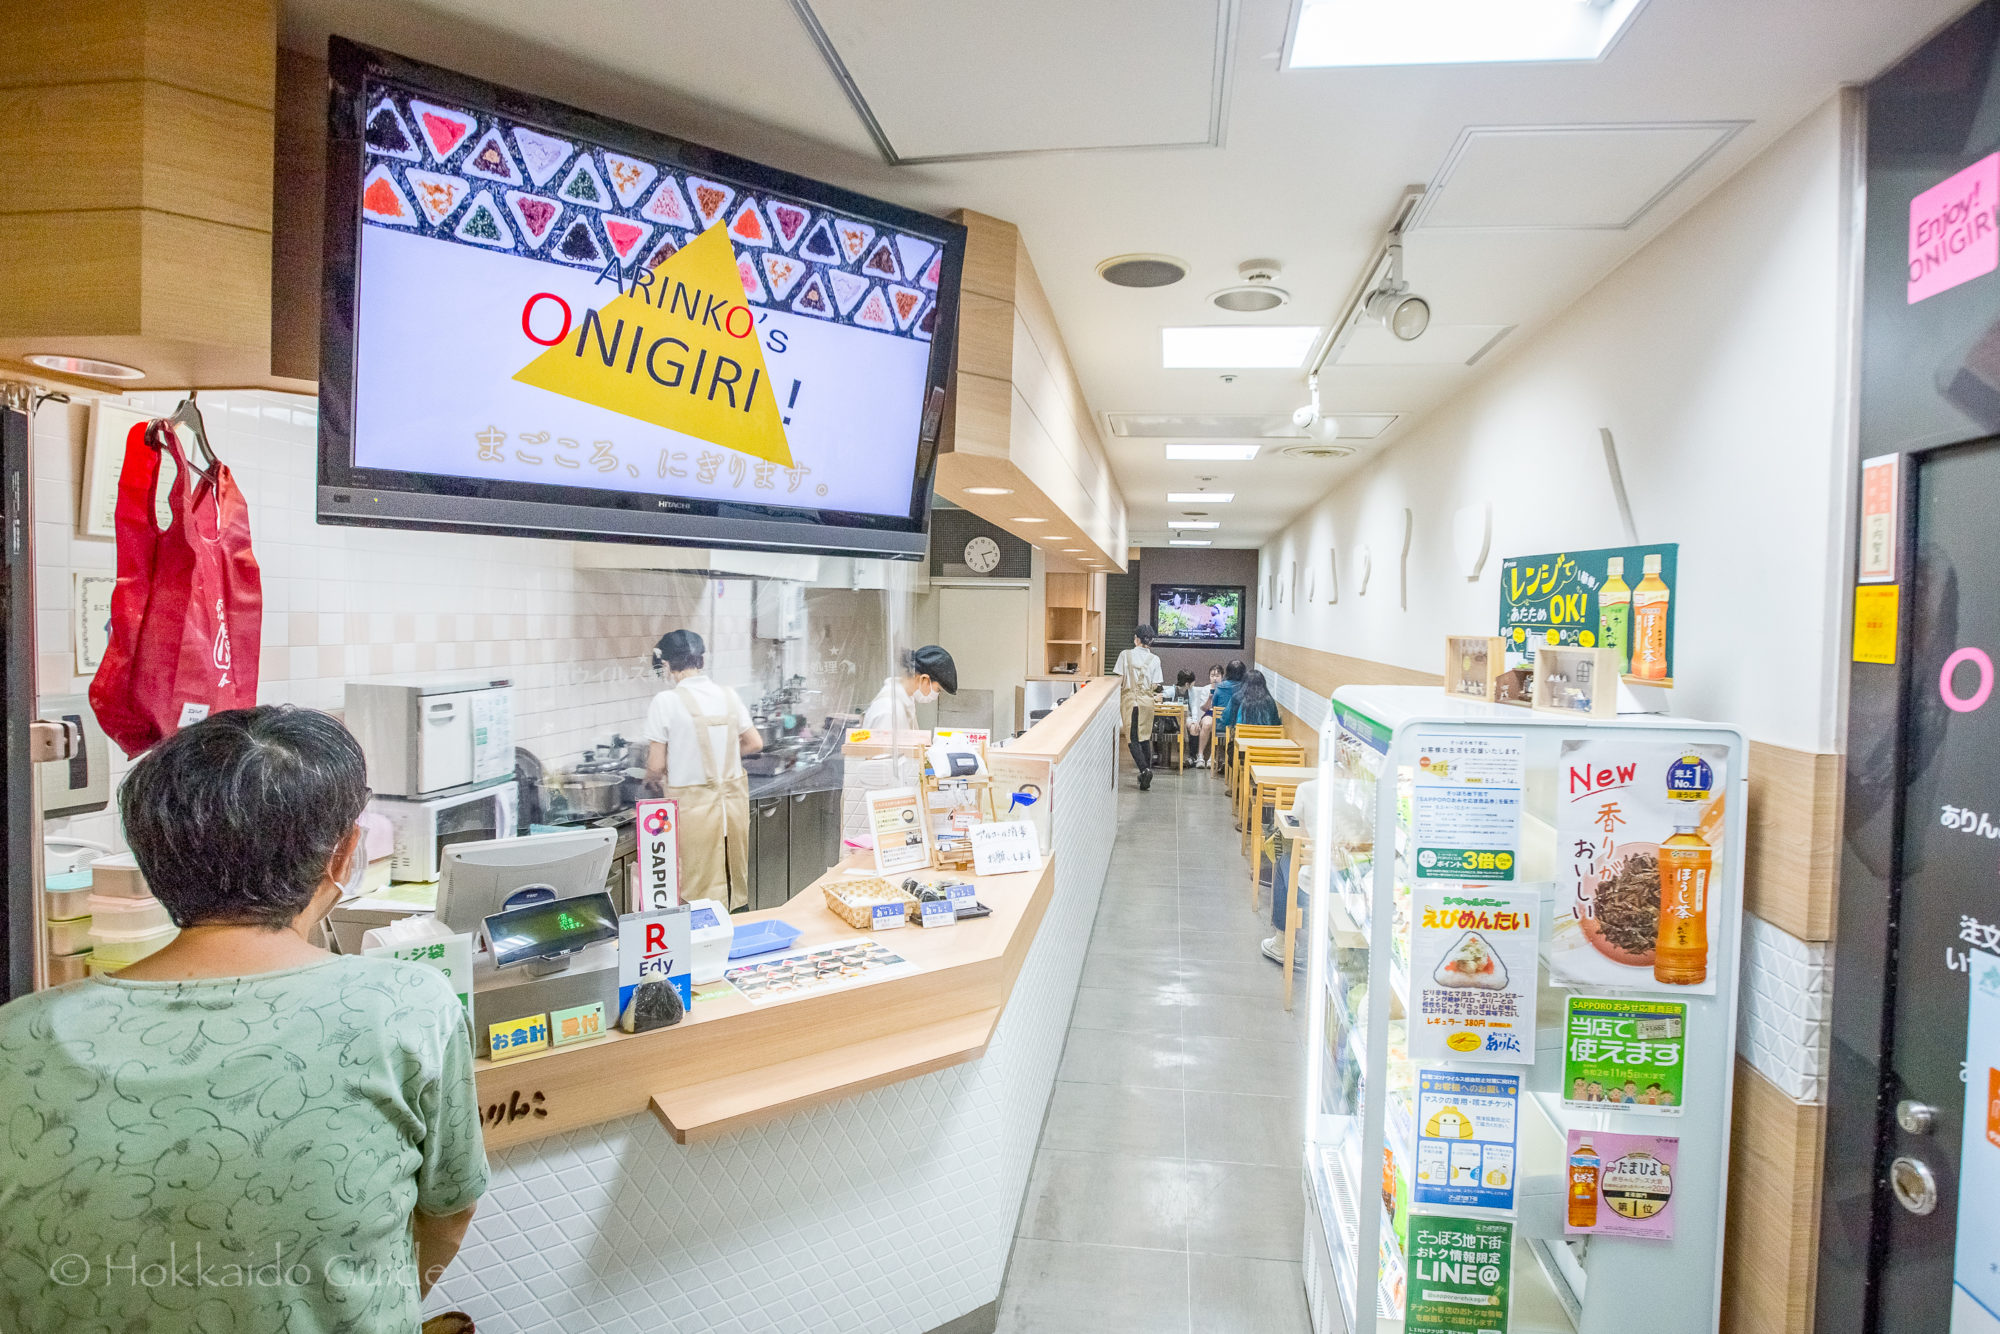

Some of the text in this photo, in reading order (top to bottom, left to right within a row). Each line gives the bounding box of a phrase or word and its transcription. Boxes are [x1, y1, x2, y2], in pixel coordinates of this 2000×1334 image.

[1917, 181, 1981, 248] Enjoy!
[522, 293, 760, 413] ONIGIRI
[475, 424, 830, 497] まごころ、にぎります。
[658, 500, 691, 509] HITACHI
[1511, 593, 1588, 624] あたため OK!
[1642, 614, 1657, 663] ほうじ茶
[1570, 763, 1637, 794] New
[1941, 804, 2000, 839] ありん
[1595, 802, 1627, 882] 香りが
[1573, 839, 1596, 919] おいしい
[1674, 868, 1695, 919] ほうじ茶
[1421, 909, 1530, 931] えびめんたい
[639, 958, 674, 977] Edy
[1572, 1001, 1612, 1011] SAPPORO
[491, 1023, 547, 1051] お会計
[561, 1012, 599, 1039] 受付
[1570, 1017, 1635, 1038] 当店で
[1569, 1038, 1681, 1067] 使えます
[478, 1090, 548, 1129] りんこ
[1617, 1161, 1658, 1176] たまひよ
[1618, 1200, 1653, 1217] 第1位
[1417, 1229, 1502, 1250] さっぽろ地下街
[1417, 1246, 1501, 1265] おトク情報限定
[1416, 1259, 1500, 1287] LINE@
